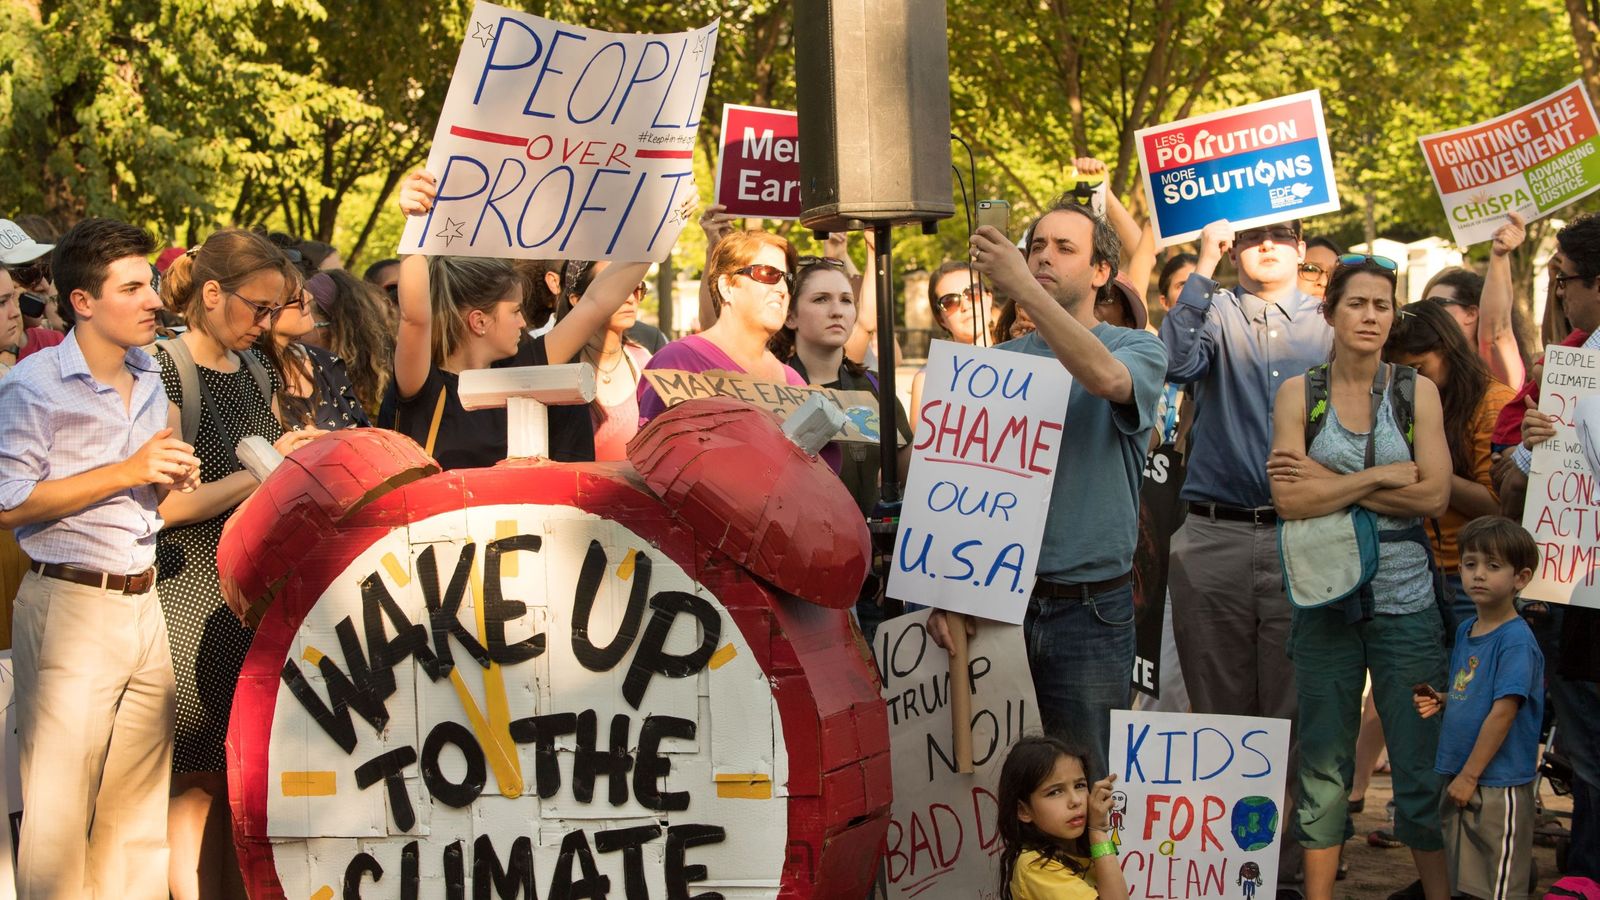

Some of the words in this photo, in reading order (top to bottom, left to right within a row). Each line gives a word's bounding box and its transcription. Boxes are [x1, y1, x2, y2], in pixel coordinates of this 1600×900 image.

[473, 17, 717, 129] PEOPLE
[526, 134, 630, 168] OVER
[1155, 132, 1185, 149] LESS
[1433, 119, 1531, 167] IGNITING
[1531, 96, 1580, 133] THE
[1161, 168, 1196, 185] MORE
[1451, 122, 1585, 190] MOVEMENT.
[1529, 142, 1595, 184] ADVANCING
[1532, 162, 1584, 195] CLIMATE
[1163, 155, 1313, 205] SOLUTIONS
[1269, 186, 1291, 198] EDF
[1539, 176, 1588, 206] JUSTICE.
[418, 155, 692, 255] PROFIT
[950, 355, 1033, 401] YOU
[1547, 373, 1597, 389] CLIMATE
[1550, 350, 1596, 369] PEOPLE
[654, 373, 755, 404] MAKE
[913, 400, 1062, 475] SHAME
[927, 481, 1017, 521] OUR
[1535, 505, 1586, 539] ACT
[899, 527, 1024, 594] U.S.A.
[279, 534, 546, 755] WAKE
[571, 540, 722, 710] UP
[354, 720, 487, 833] TO
[509, 708, 697, 811] THE
[1124, 723, 1271, 785] KIDS
[883, 803, 964, 884] BAD
[1142, 795, 1227, 852] FOR
[342, 824, 727, 900] CLIMATE
[1159, 840, 1175, 856] a
[1120, 850, 1228, 899] CLEAN
